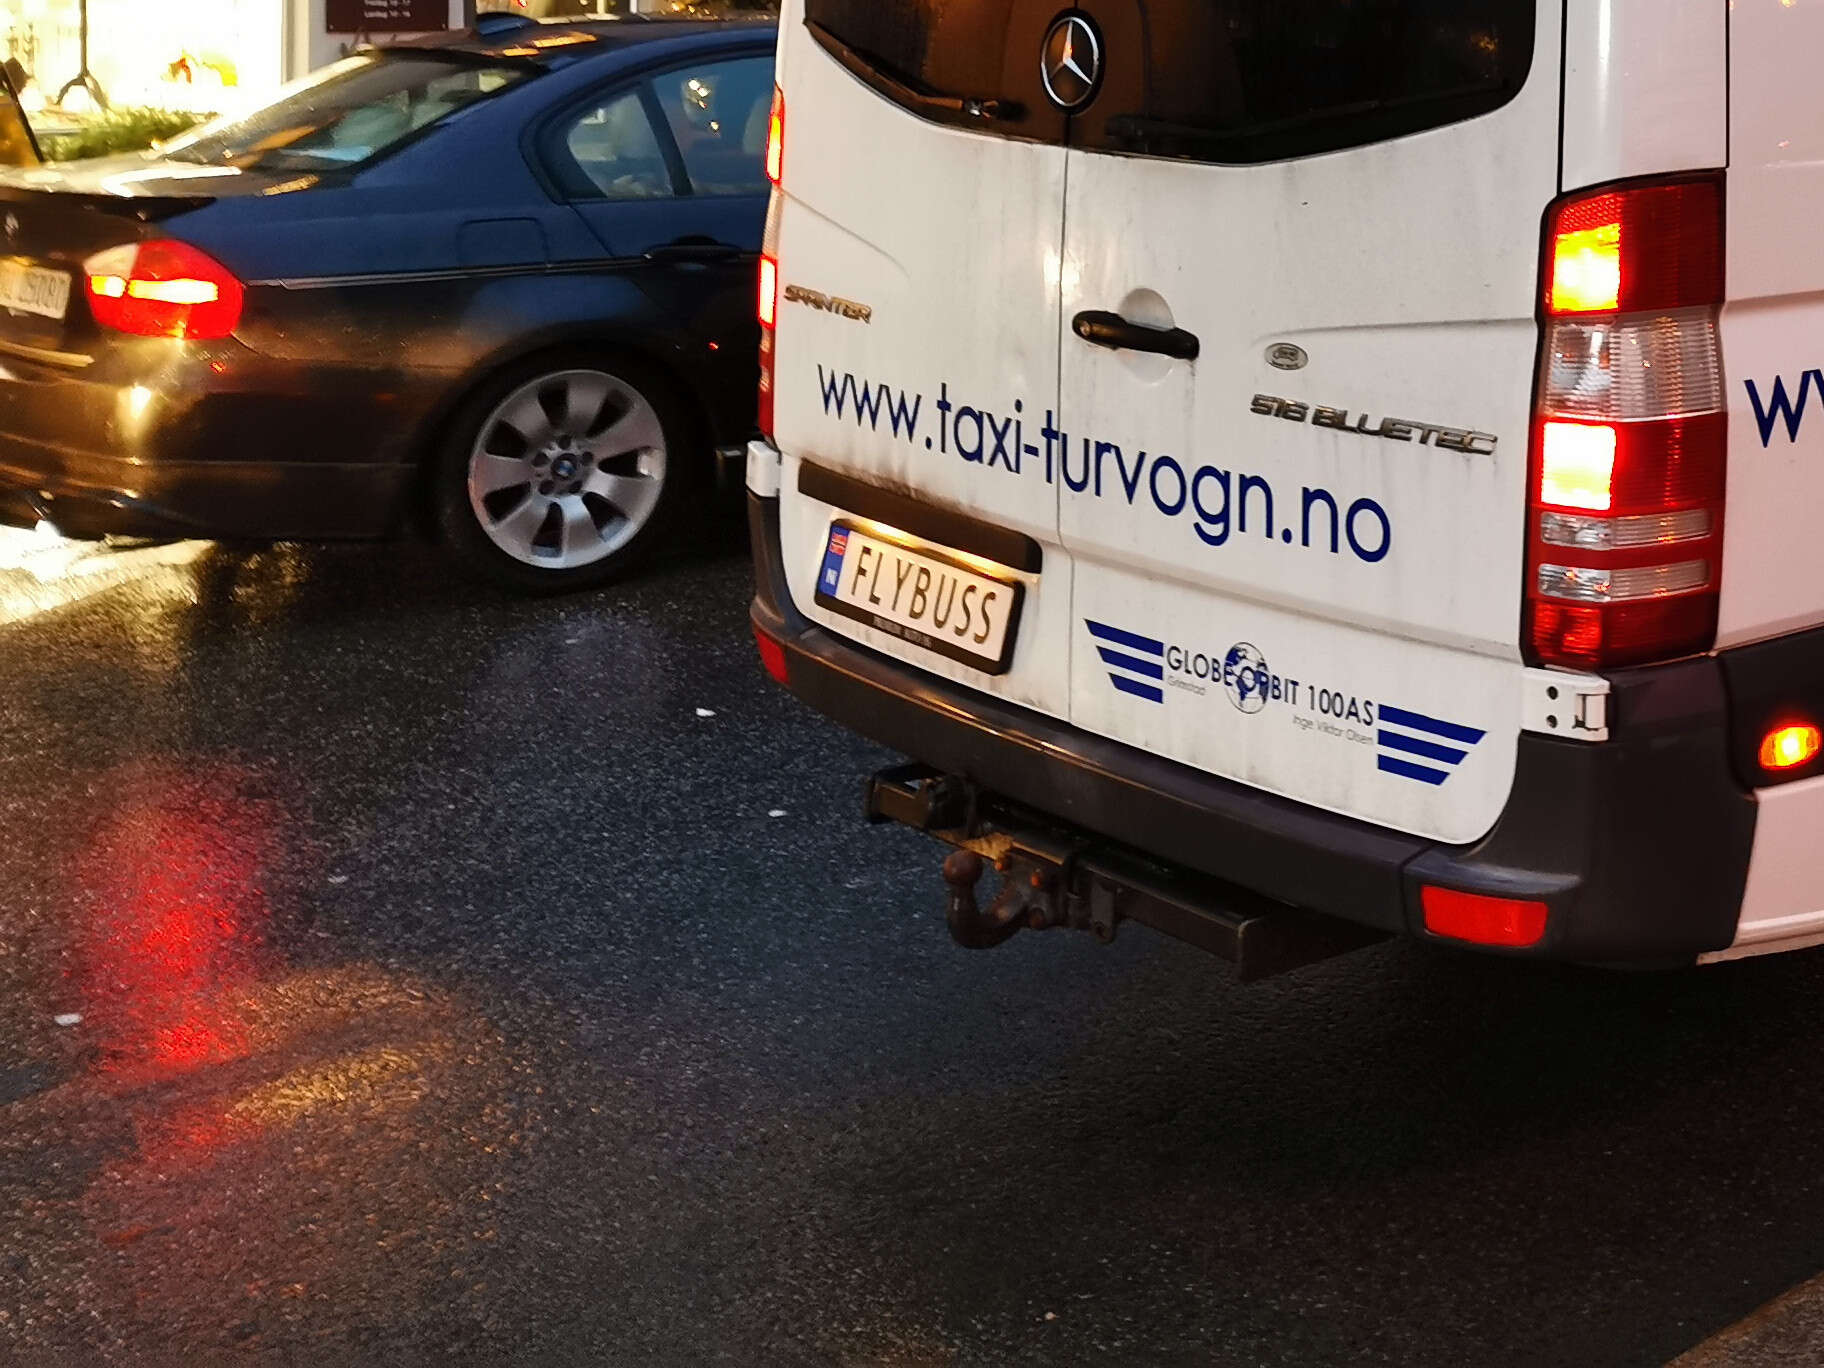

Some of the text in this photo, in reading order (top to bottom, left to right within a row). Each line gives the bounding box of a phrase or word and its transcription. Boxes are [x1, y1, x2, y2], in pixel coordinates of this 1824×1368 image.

[817, 363, 1392, 563] www.taxi-turvogn.no
[1311, 404, 1498, 457] BLUETEC
[851, 545, 997, 644] FLYBUSS
